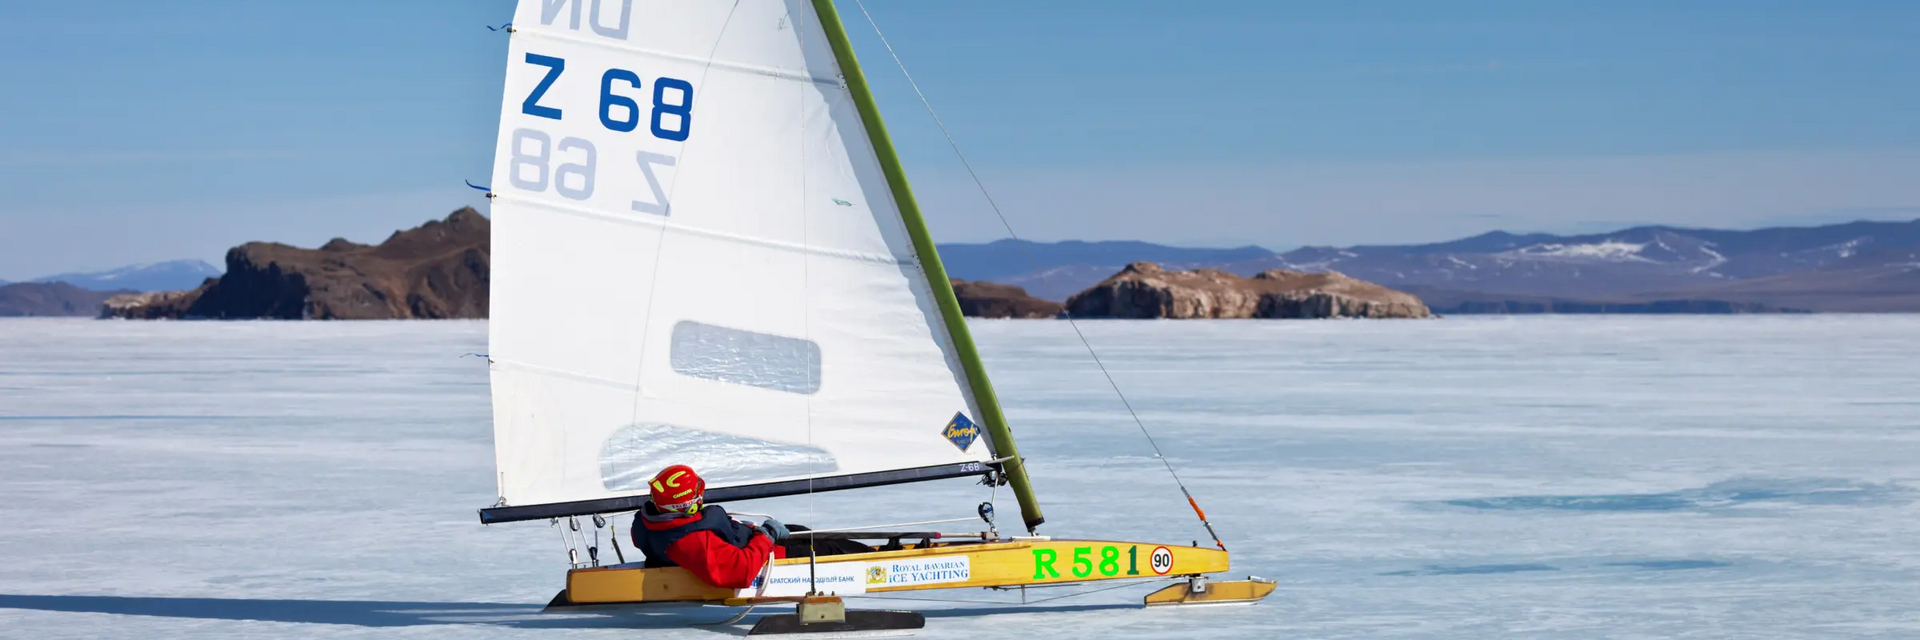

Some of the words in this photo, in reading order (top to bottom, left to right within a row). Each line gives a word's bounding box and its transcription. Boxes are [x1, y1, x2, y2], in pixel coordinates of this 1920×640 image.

[522, 52, 565, 120] Z
[599, 68, 693, 142] 68
[959, 462, 980, 472] Z-68
[1032, 548, 1060, 579] R
[1072, 545, 1139, 578] 581
[1154, 553, 1170, 567] 90
[892, 564, 921, 573] ROYAL
[924, 561, 965, 570] BAVARIAN
[770, 576, 801, 584] БРАТСКИЙ
[911, 569, 968, 582] YACHTING
